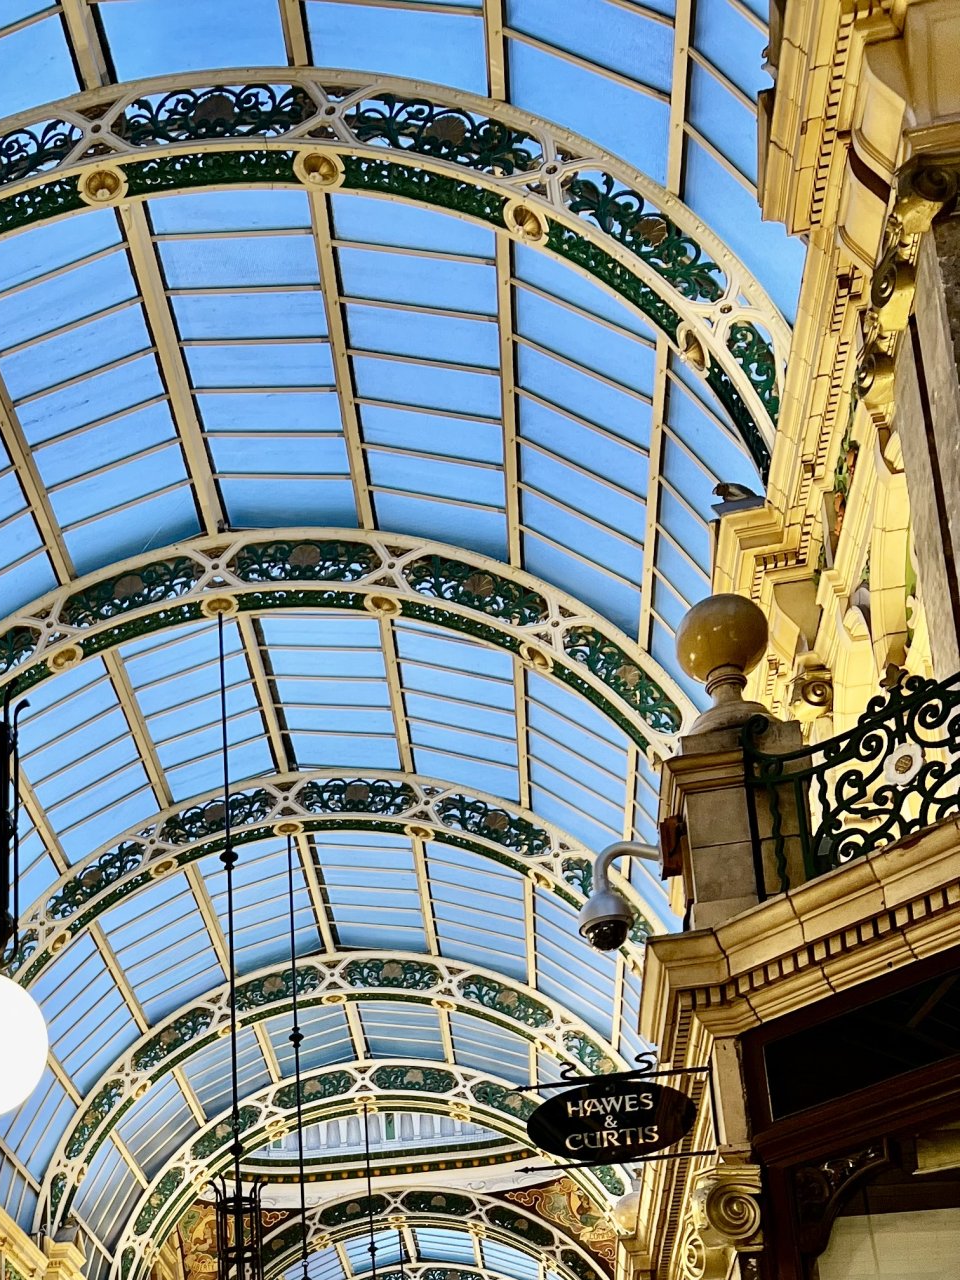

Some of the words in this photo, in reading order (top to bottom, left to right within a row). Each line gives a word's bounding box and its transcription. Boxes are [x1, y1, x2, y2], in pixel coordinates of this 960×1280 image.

[566, 1093, 654, 1118] HAWES
[604, 1114, 618, 1128] &
[565, 1125, 659, 1151] CURTIS
